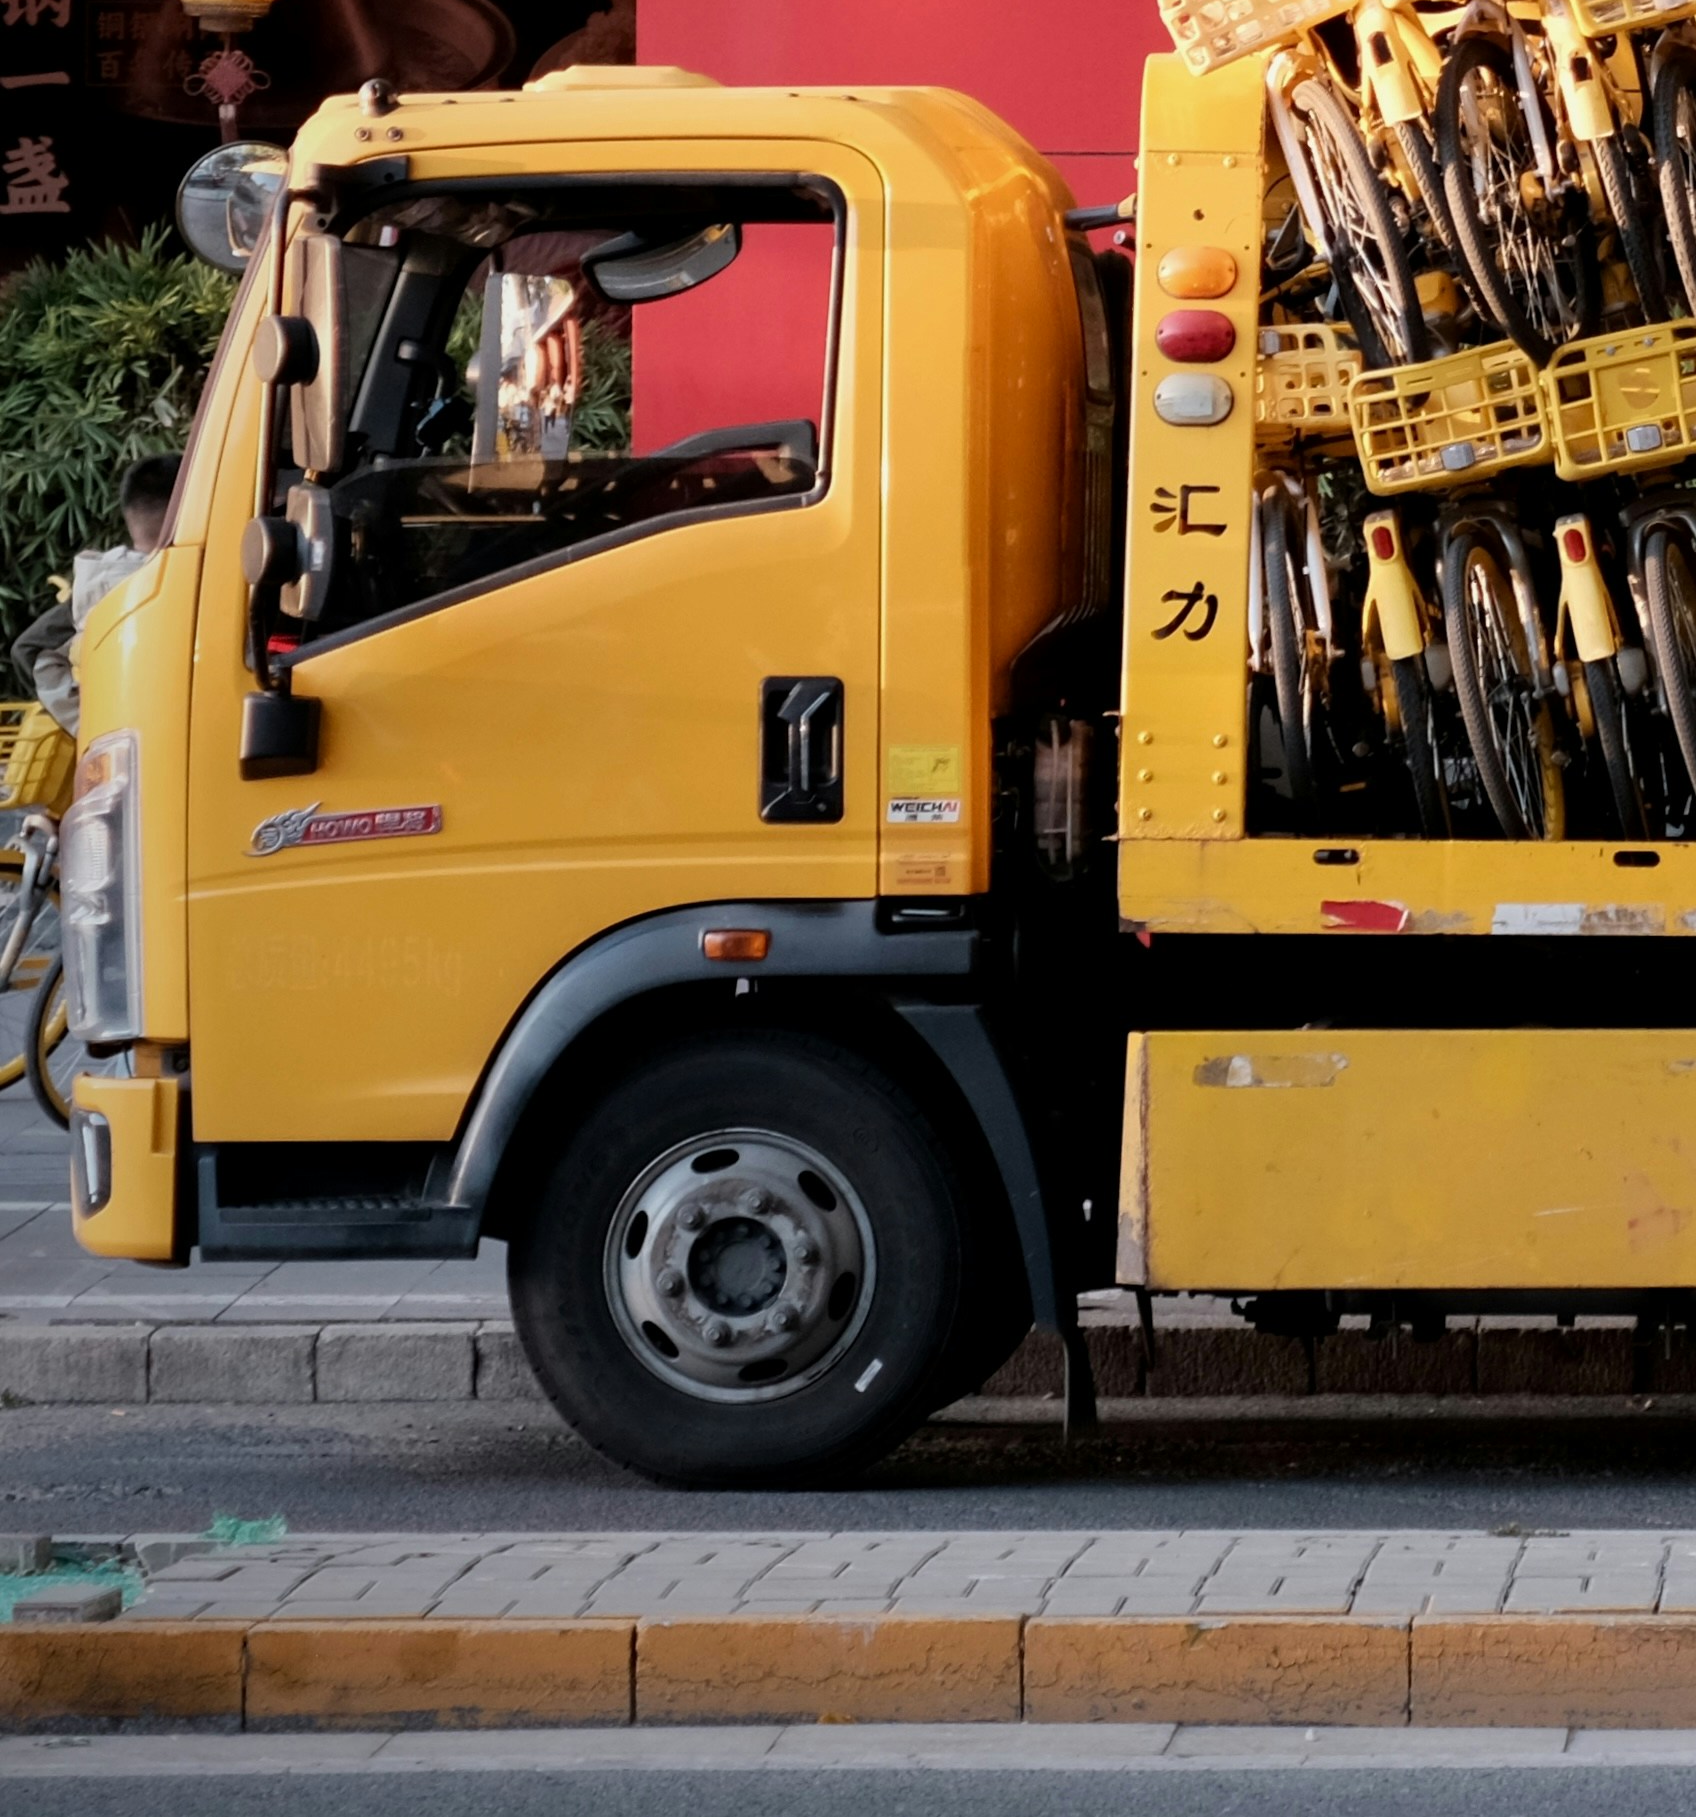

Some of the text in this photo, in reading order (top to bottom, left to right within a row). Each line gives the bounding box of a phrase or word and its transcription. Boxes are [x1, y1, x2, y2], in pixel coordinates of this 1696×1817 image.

[1149, 484, 1227, 641] 汇力
[890, 801, 958, 813] WEICHAI
[311, 816, 373, 840] HOWO
